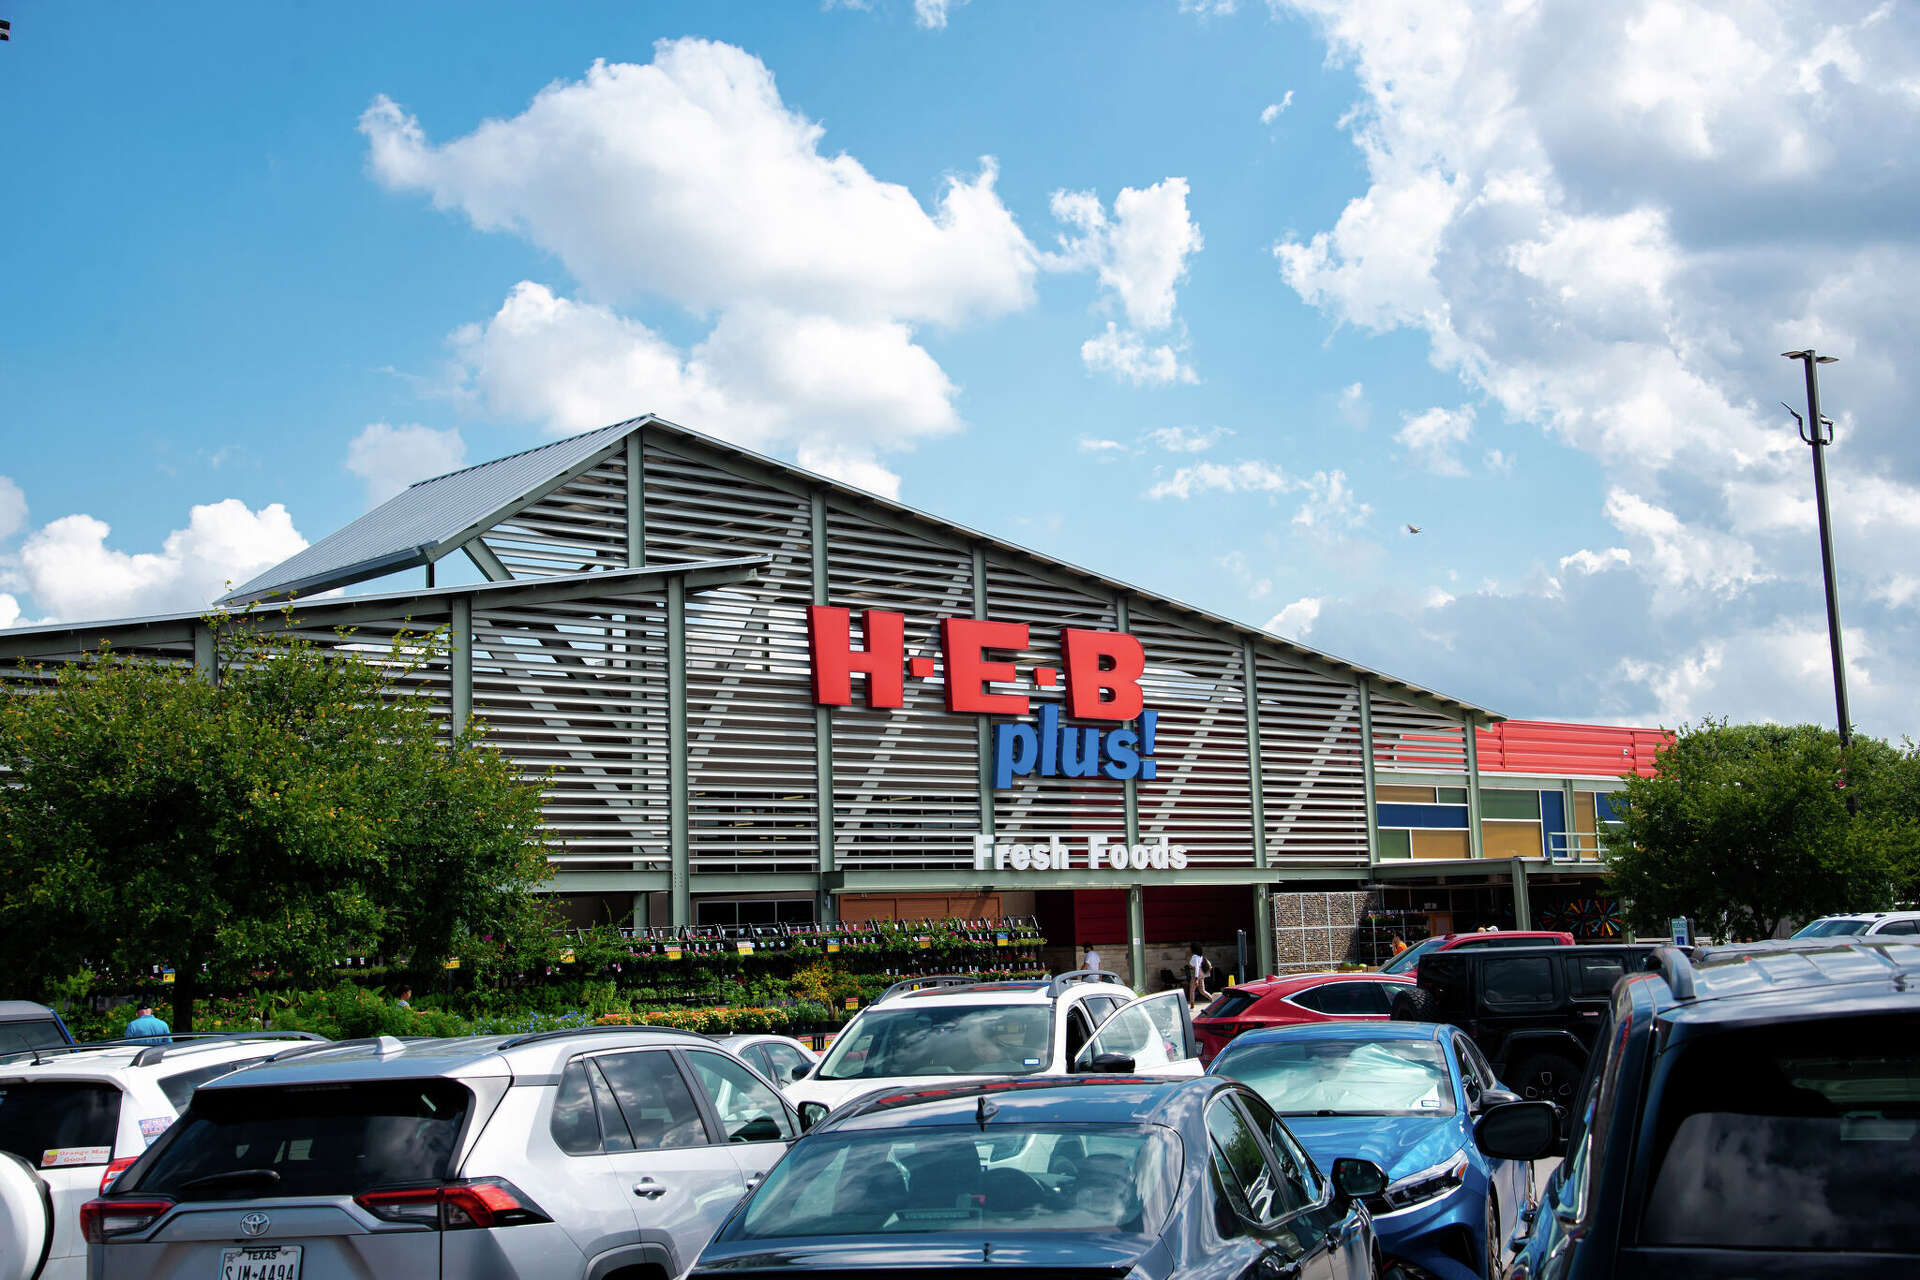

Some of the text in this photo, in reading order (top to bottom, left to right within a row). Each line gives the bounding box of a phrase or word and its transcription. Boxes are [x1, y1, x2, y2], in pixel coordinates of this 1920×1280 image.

[992, 703, 1159, 789] plus!
[973, 834, 1188, 871] Fresh Foods
[247, 1251, 277, 1260] TEXAS
